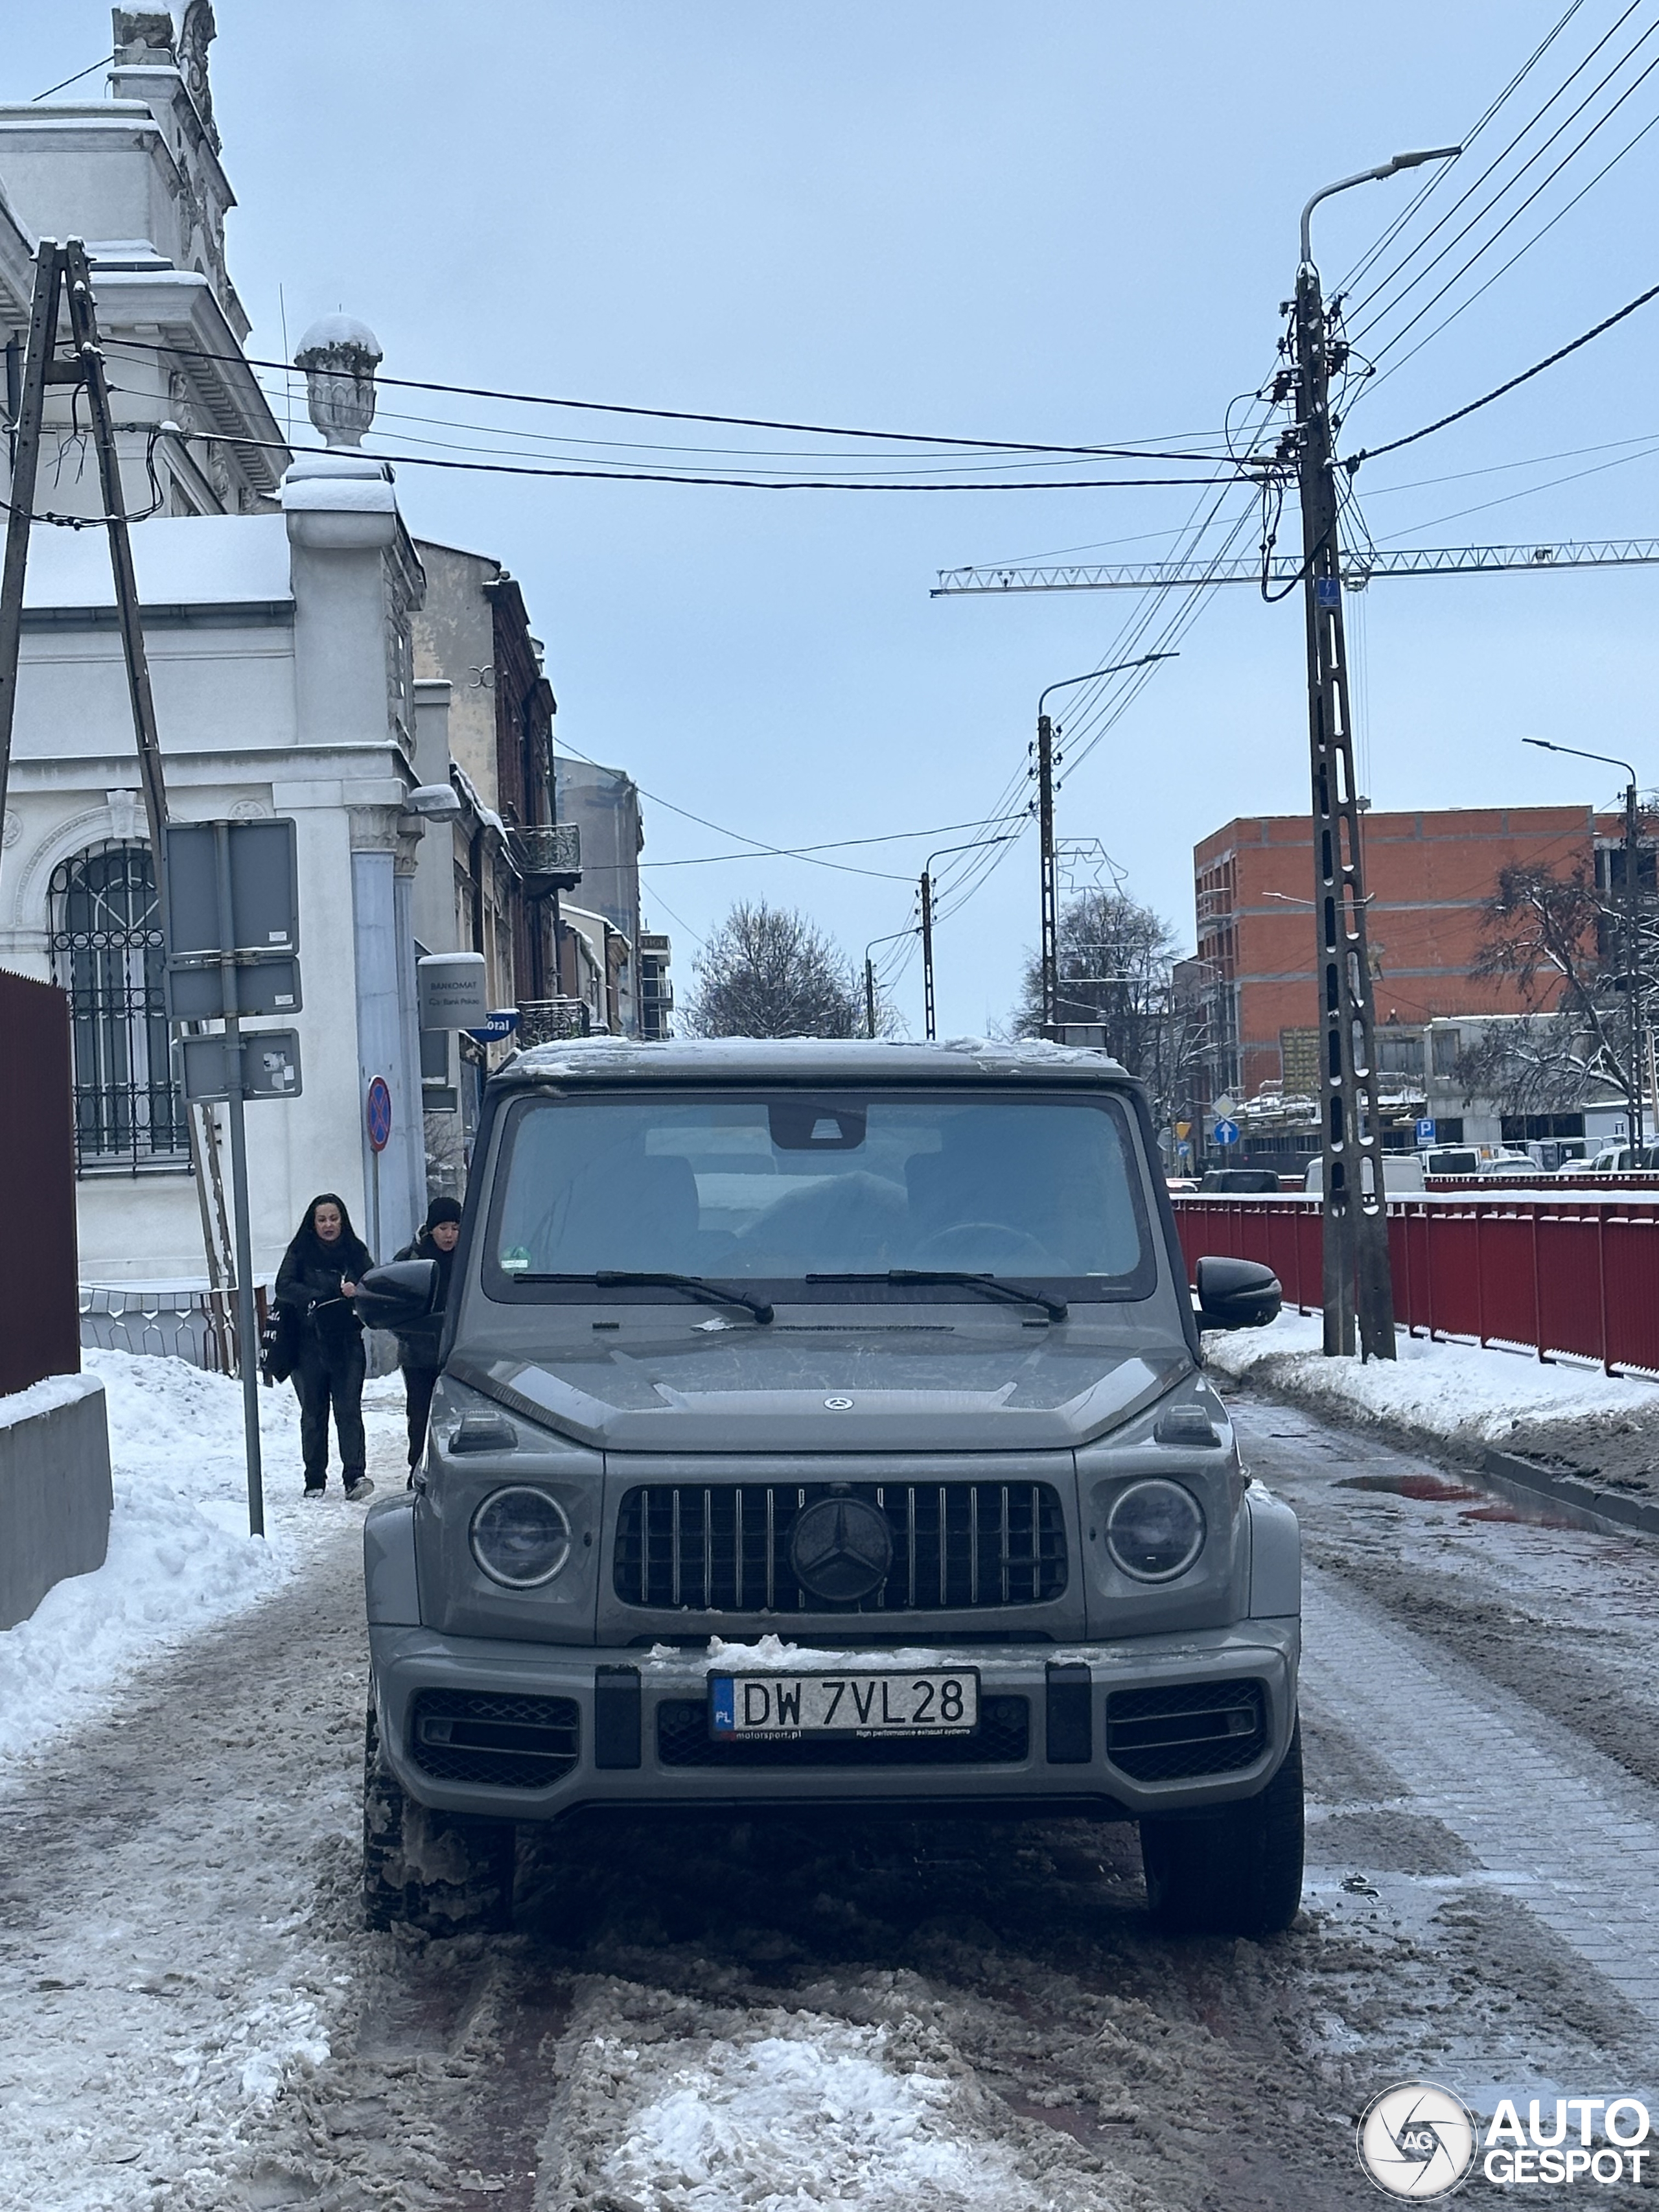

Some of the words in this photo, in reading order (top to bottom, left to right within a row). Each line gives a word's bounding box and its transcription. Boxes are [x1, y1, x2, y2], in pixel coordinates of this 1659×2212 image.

[431, 981, 477, 990] BANKOMAT
[1421, 1121, 1431, 1136] P
[744, 1683, 801, 1725] DW
[822, 1680, 964, 1725] 7VL28
[715, 1711, 732, 1723] PL
